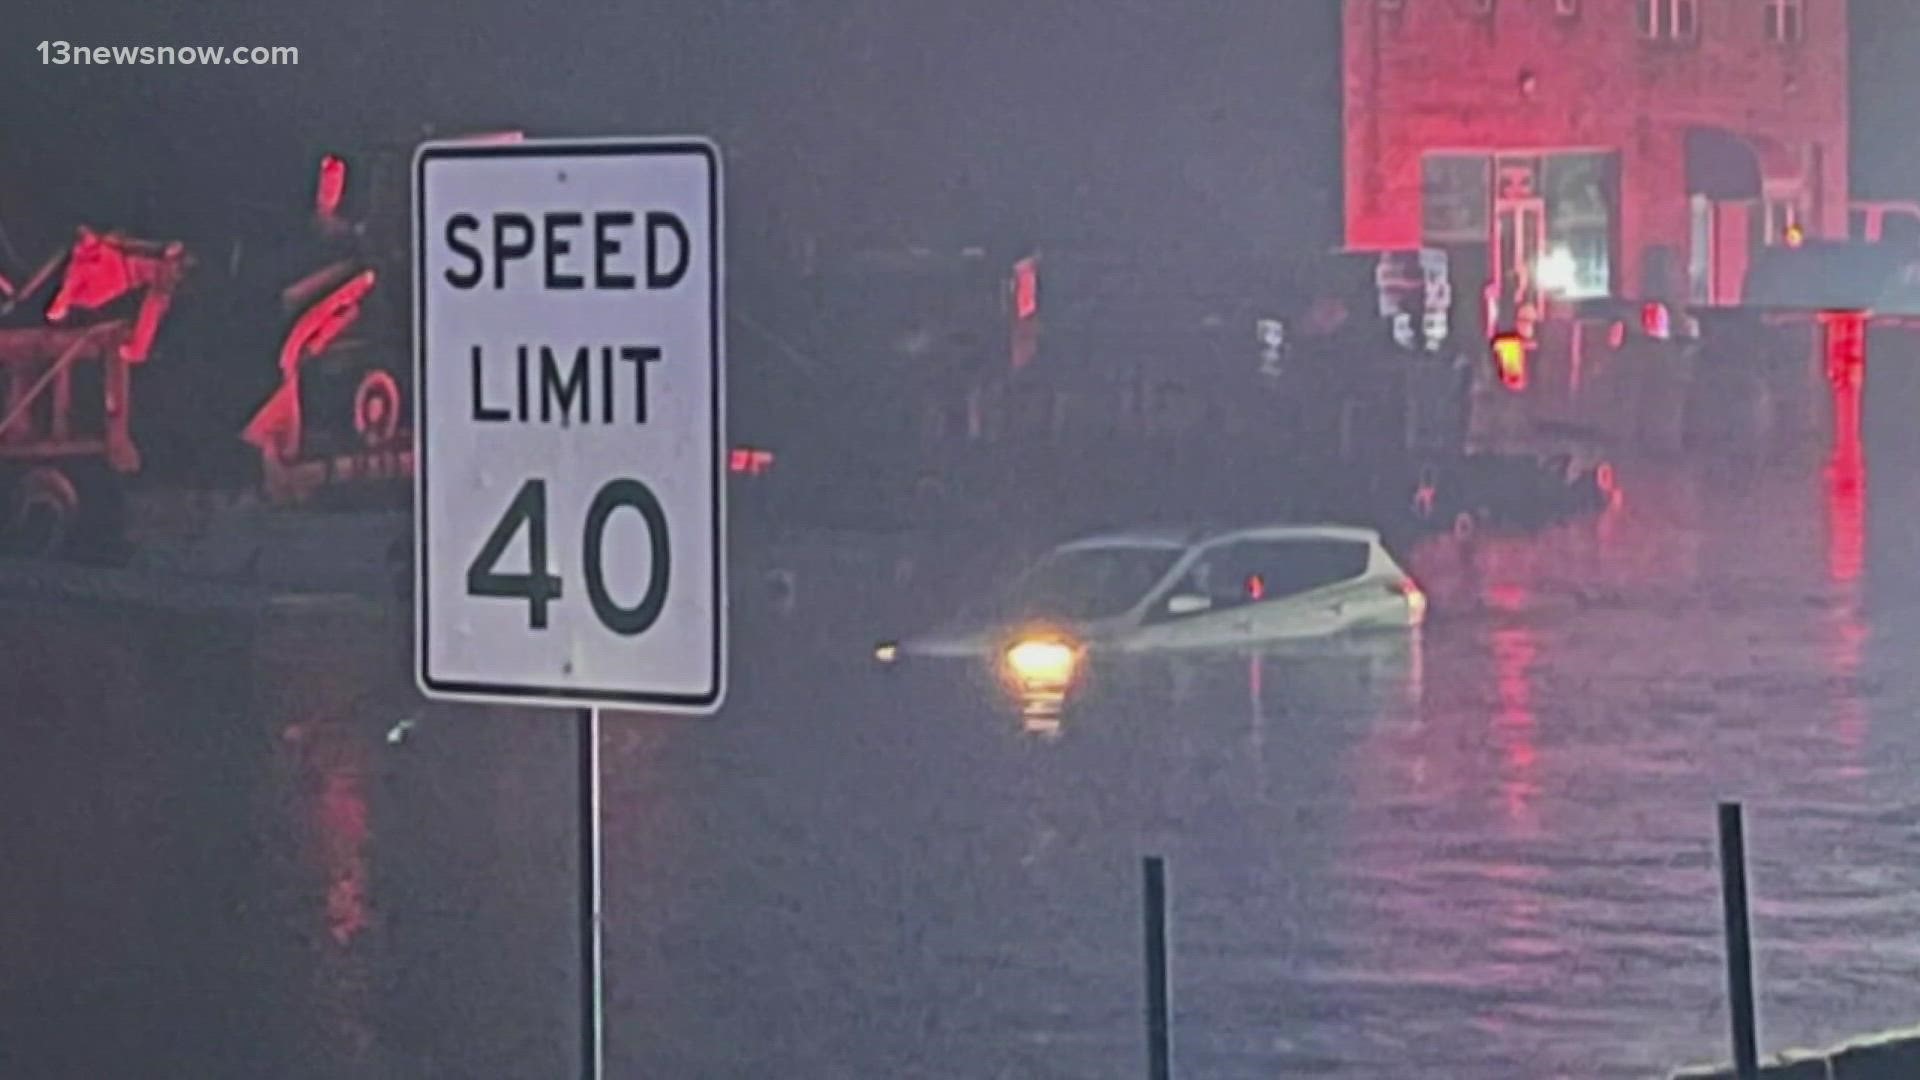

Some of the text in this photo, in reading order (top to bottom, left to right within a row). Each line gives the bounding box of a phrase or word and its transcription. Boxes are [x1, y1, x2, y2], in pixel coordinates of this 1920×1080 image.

[443, 210, 691, 291] SPEED
[471, 344, 663, 426] LIMIT
[466, 477, 672, 637] 40
